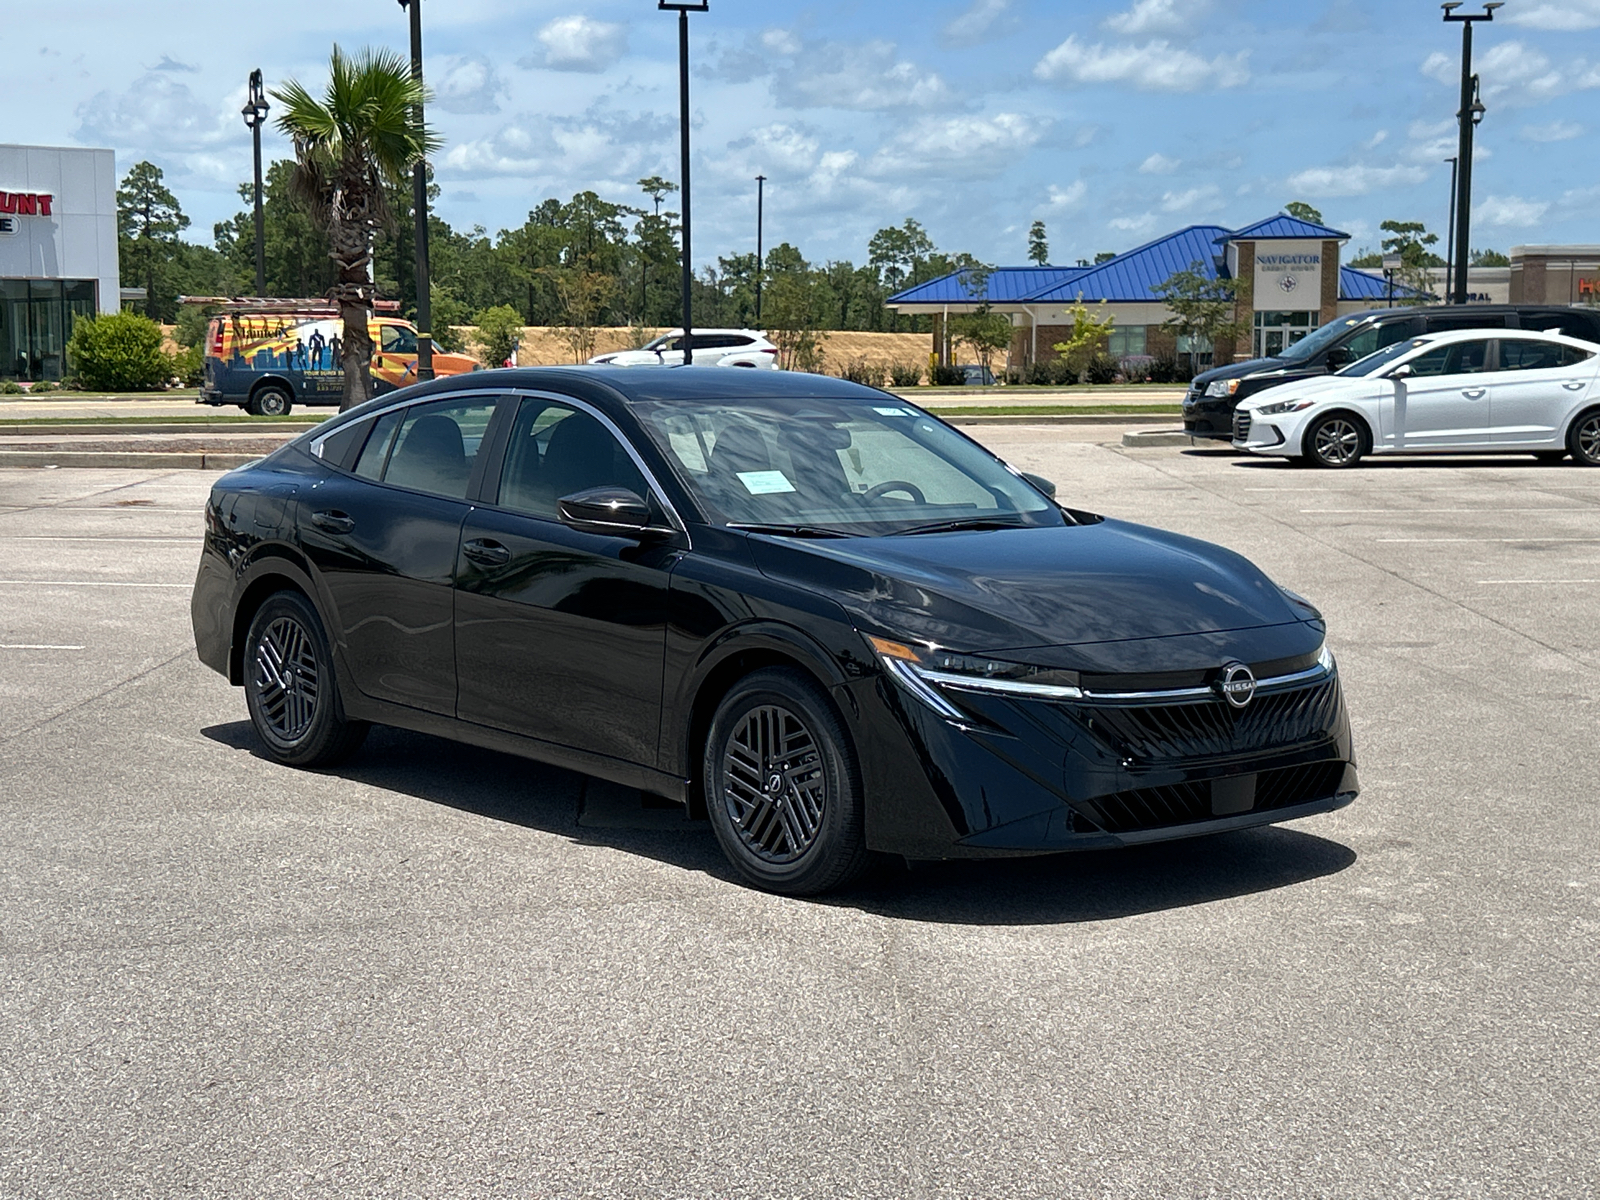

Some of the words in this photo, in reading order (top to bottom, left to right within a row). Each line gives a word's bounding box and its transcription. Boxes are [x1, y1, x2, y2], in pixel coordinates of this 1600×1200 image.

[0, 191, 53, 216] UNT
[1256, 255, 1320, 265] NAVIGATOR
[1223, 681, 1257, 692] NISSAN
